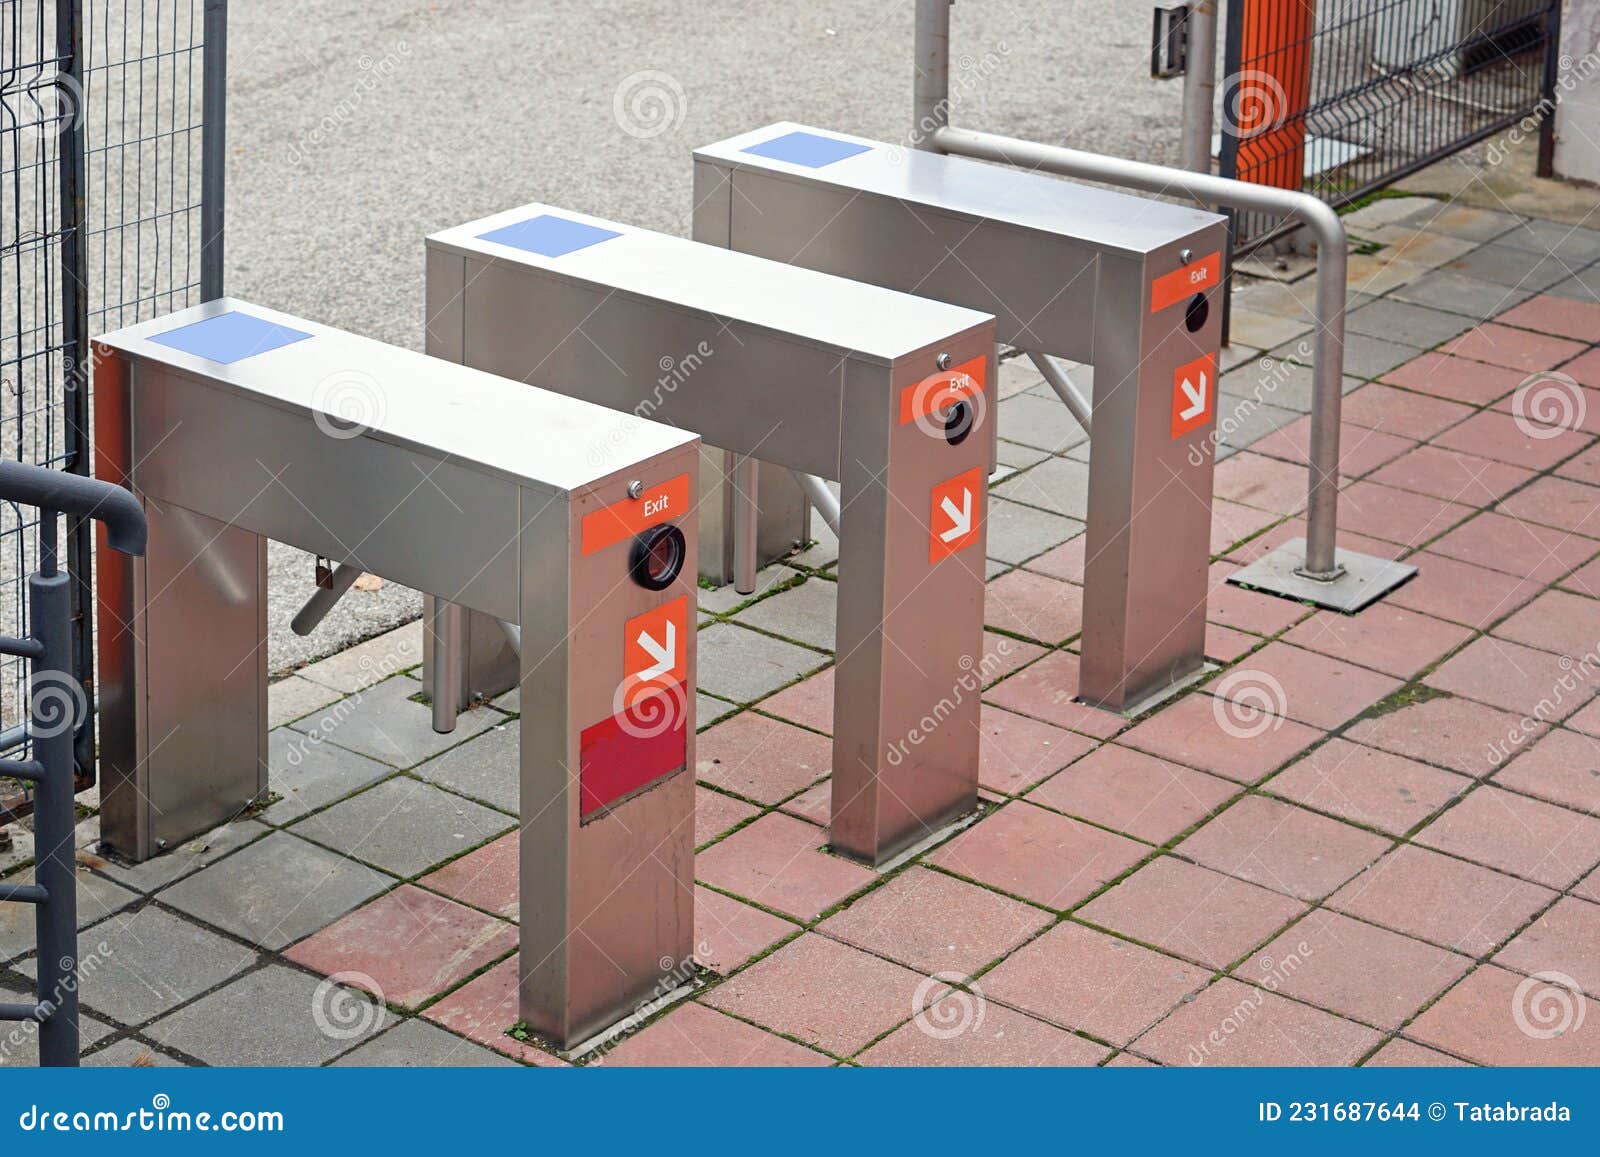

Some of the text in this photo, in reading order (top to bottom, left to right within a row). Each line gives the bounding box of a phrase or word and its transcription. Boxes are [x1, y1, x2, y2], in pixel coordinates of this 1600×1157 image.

[1190, 267, 1208, 284] Exit
[949, 374, 970, 393] Exit
[644, 495, 669, 517] Exit
